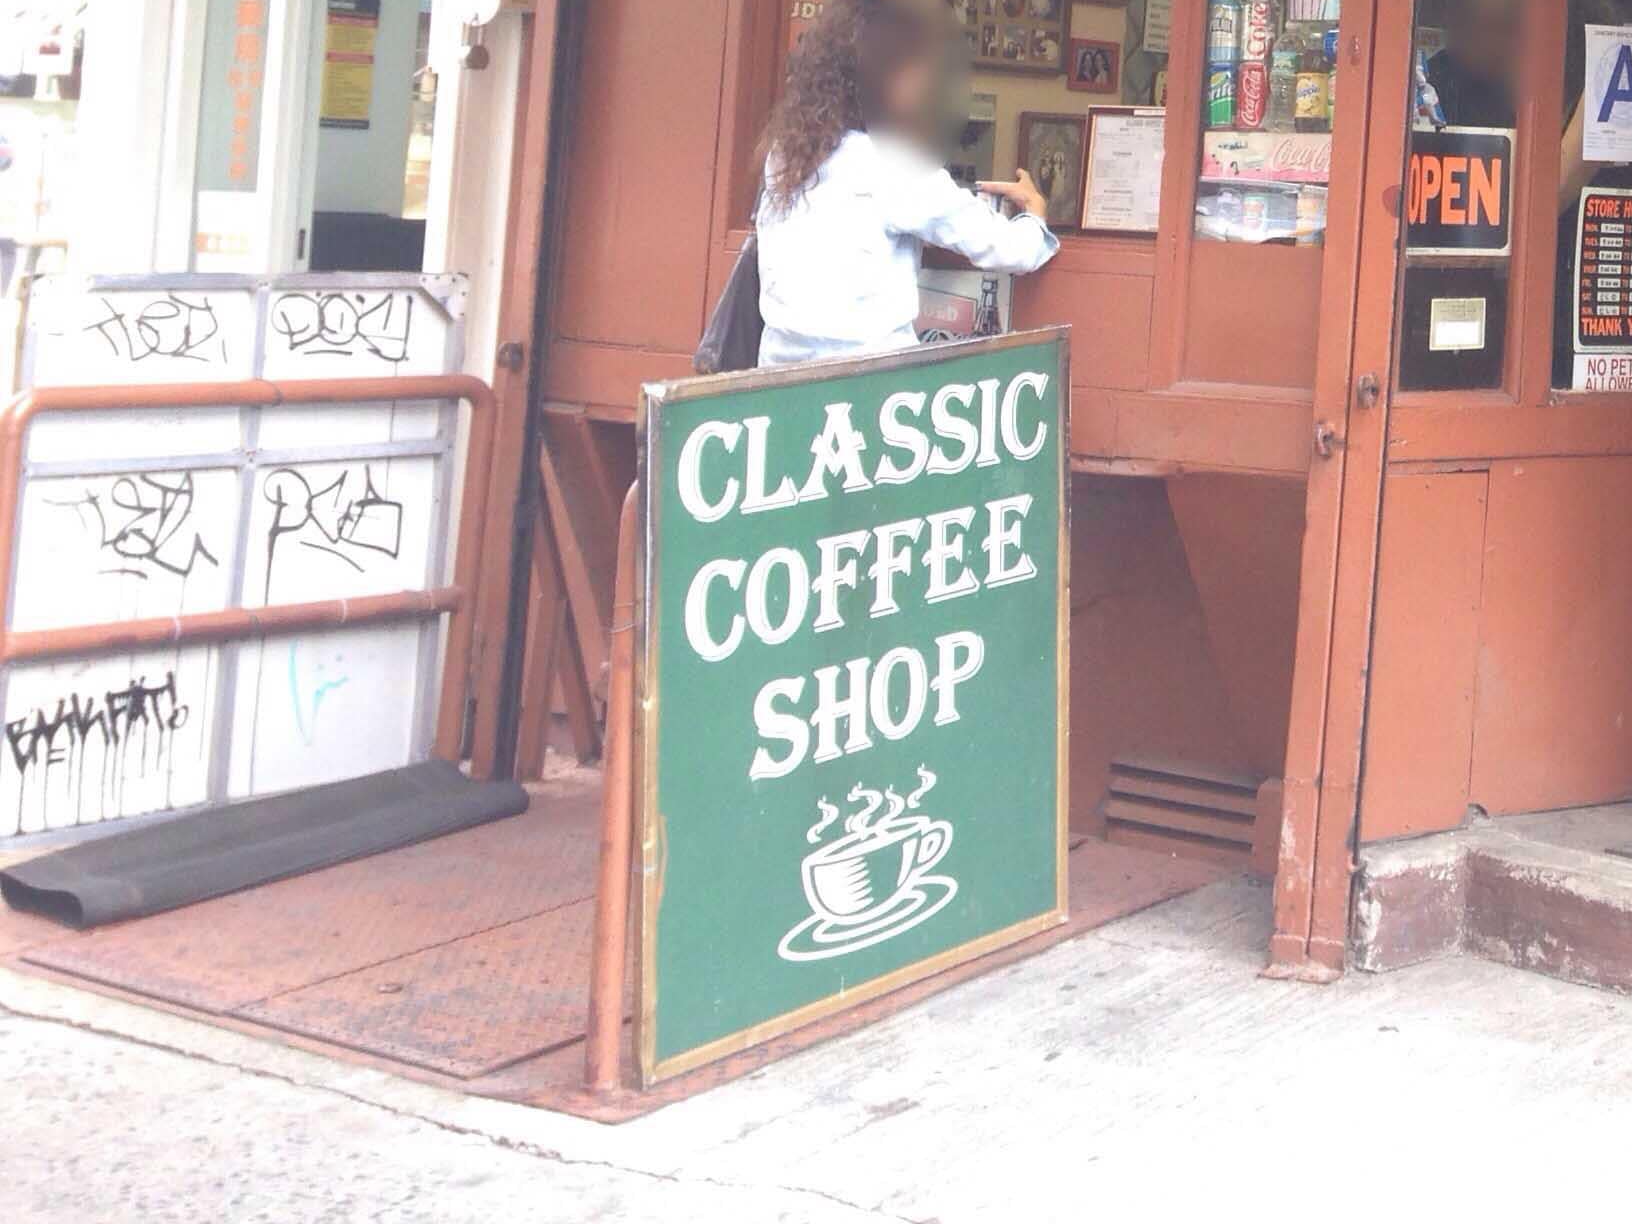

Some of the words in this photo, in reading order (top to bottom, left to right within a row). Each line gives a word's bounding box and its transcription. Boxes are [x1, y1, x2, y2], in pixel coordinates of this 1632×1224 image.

[1408, 152, 1502, 226] OPEN
[1586, 199, 1620, 218] STORE
[1581, 317, 1622, 336] THANK
[1587, 358, 1606, 376] NO
[677, 371, 1049, 523] CLASSIC
[684, 493, 1038, 663] COFFEE
[749, 630, 985, 783] SHOP
